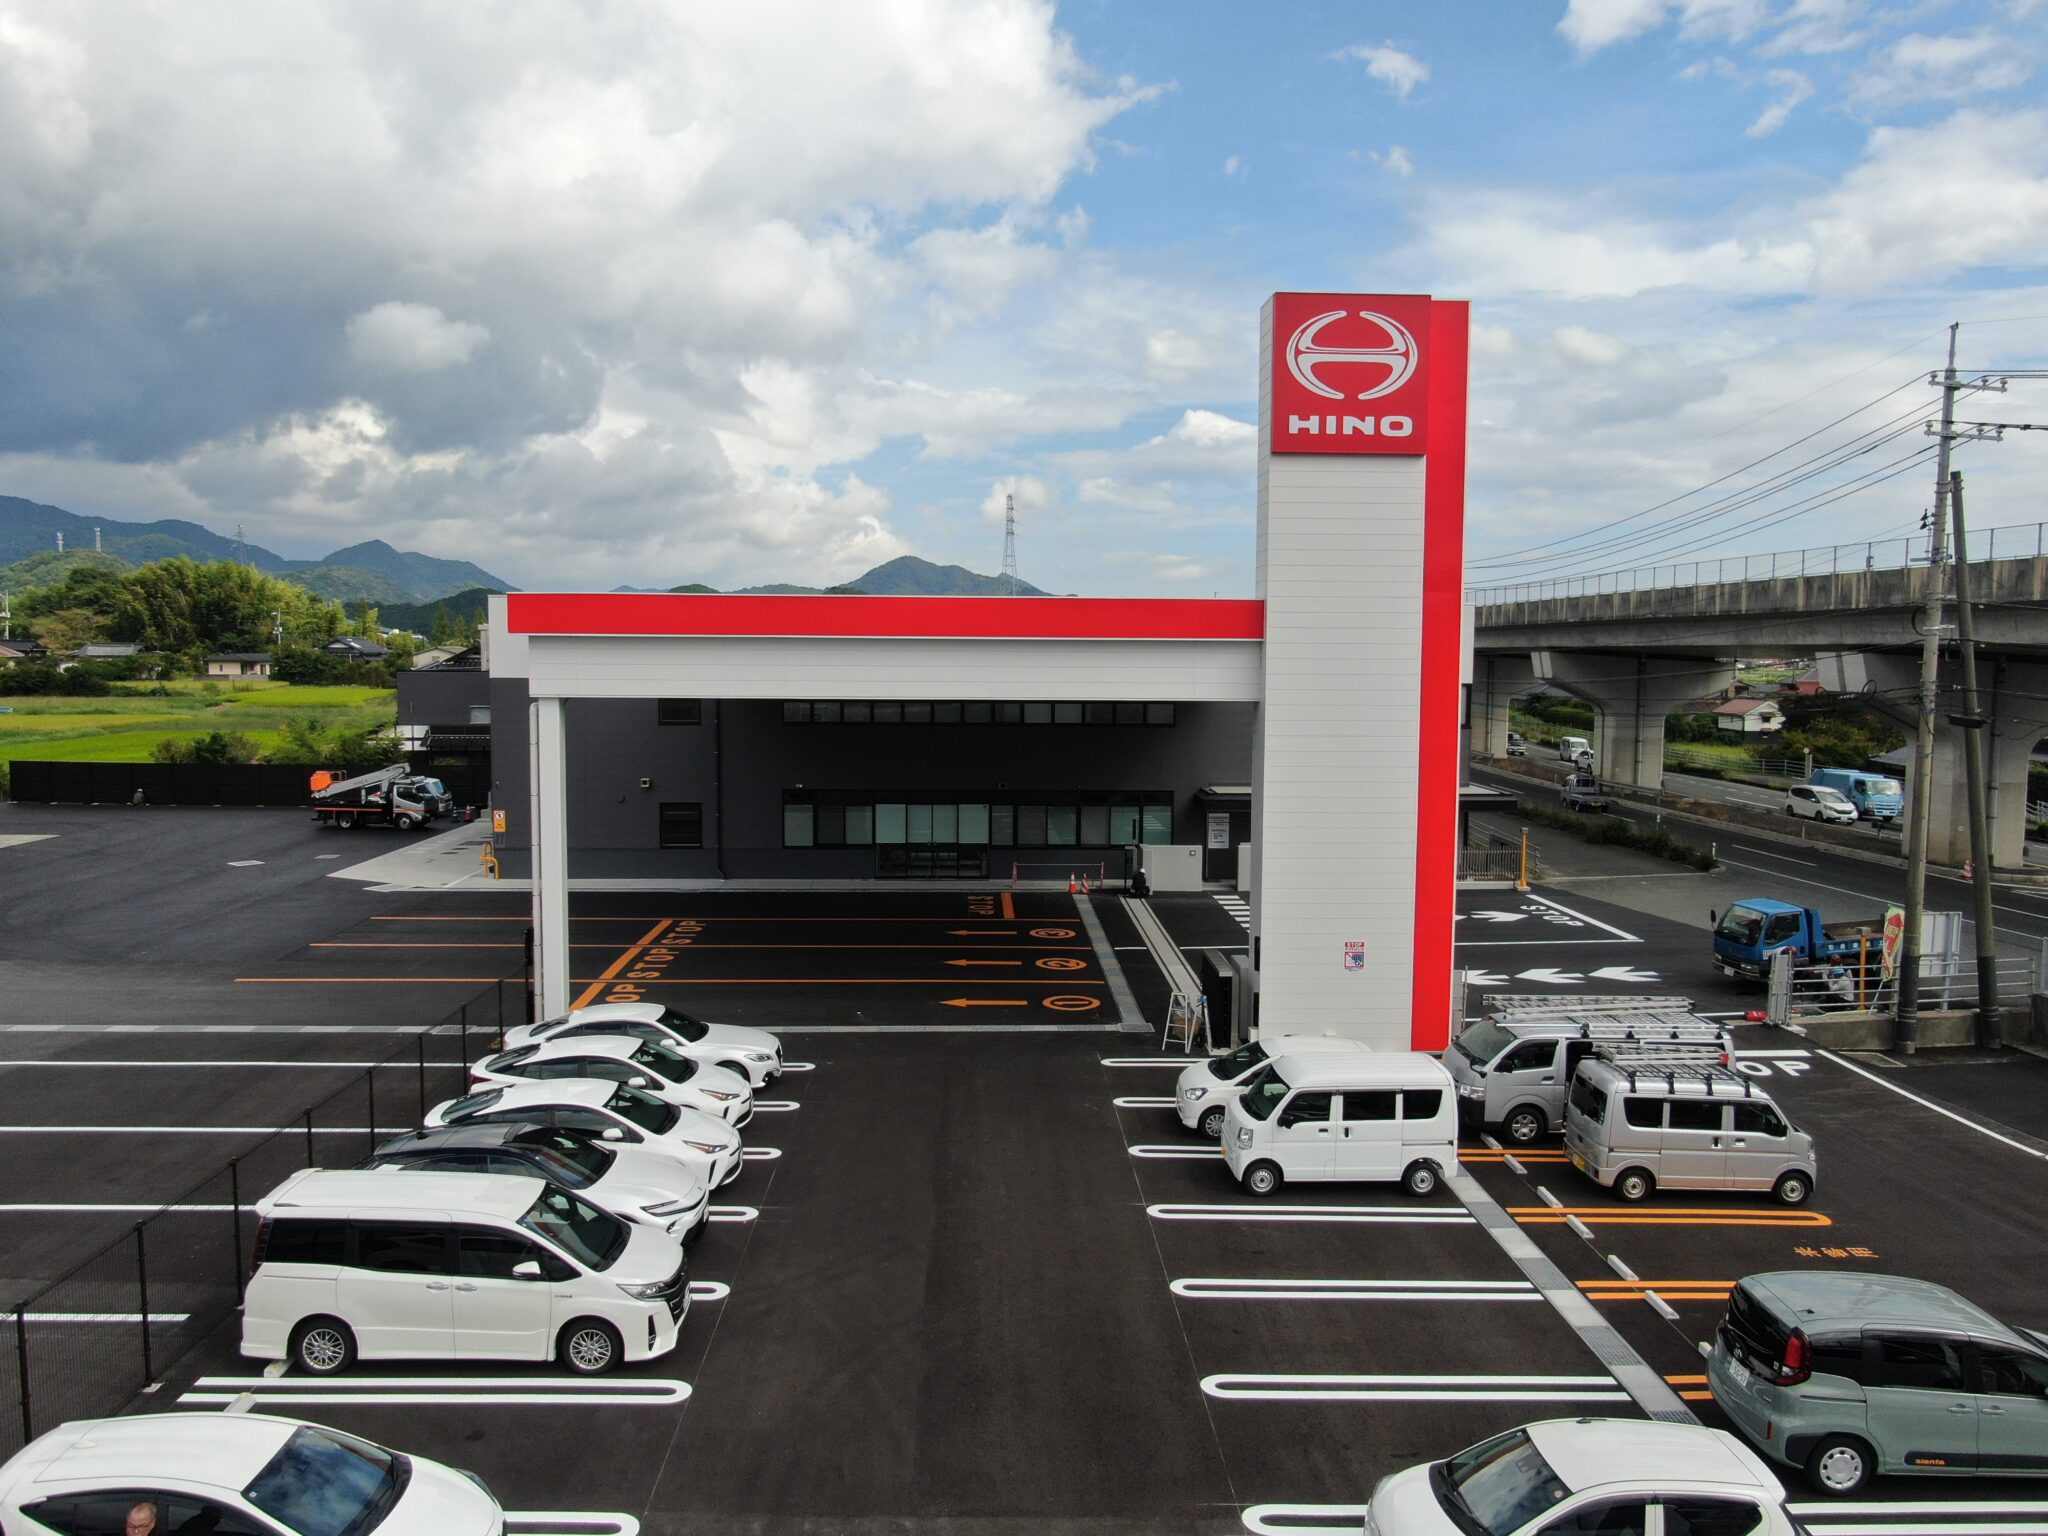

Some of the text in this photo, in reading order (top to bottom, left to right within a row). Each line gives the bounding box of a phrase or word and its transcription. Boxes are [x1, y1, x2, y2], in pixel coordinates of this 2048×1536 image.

[1288, 415, 1413, 437] HINO
[968, 895, 994, 915] STOP
[1520, 905, 1585, 926] STOP
[660, 920, 707, 944] STOP
[626, 948, 679, 978] STOP
[605, 983, 647, 1003] OP
[1736, 1061, 1811, 1076] OP
